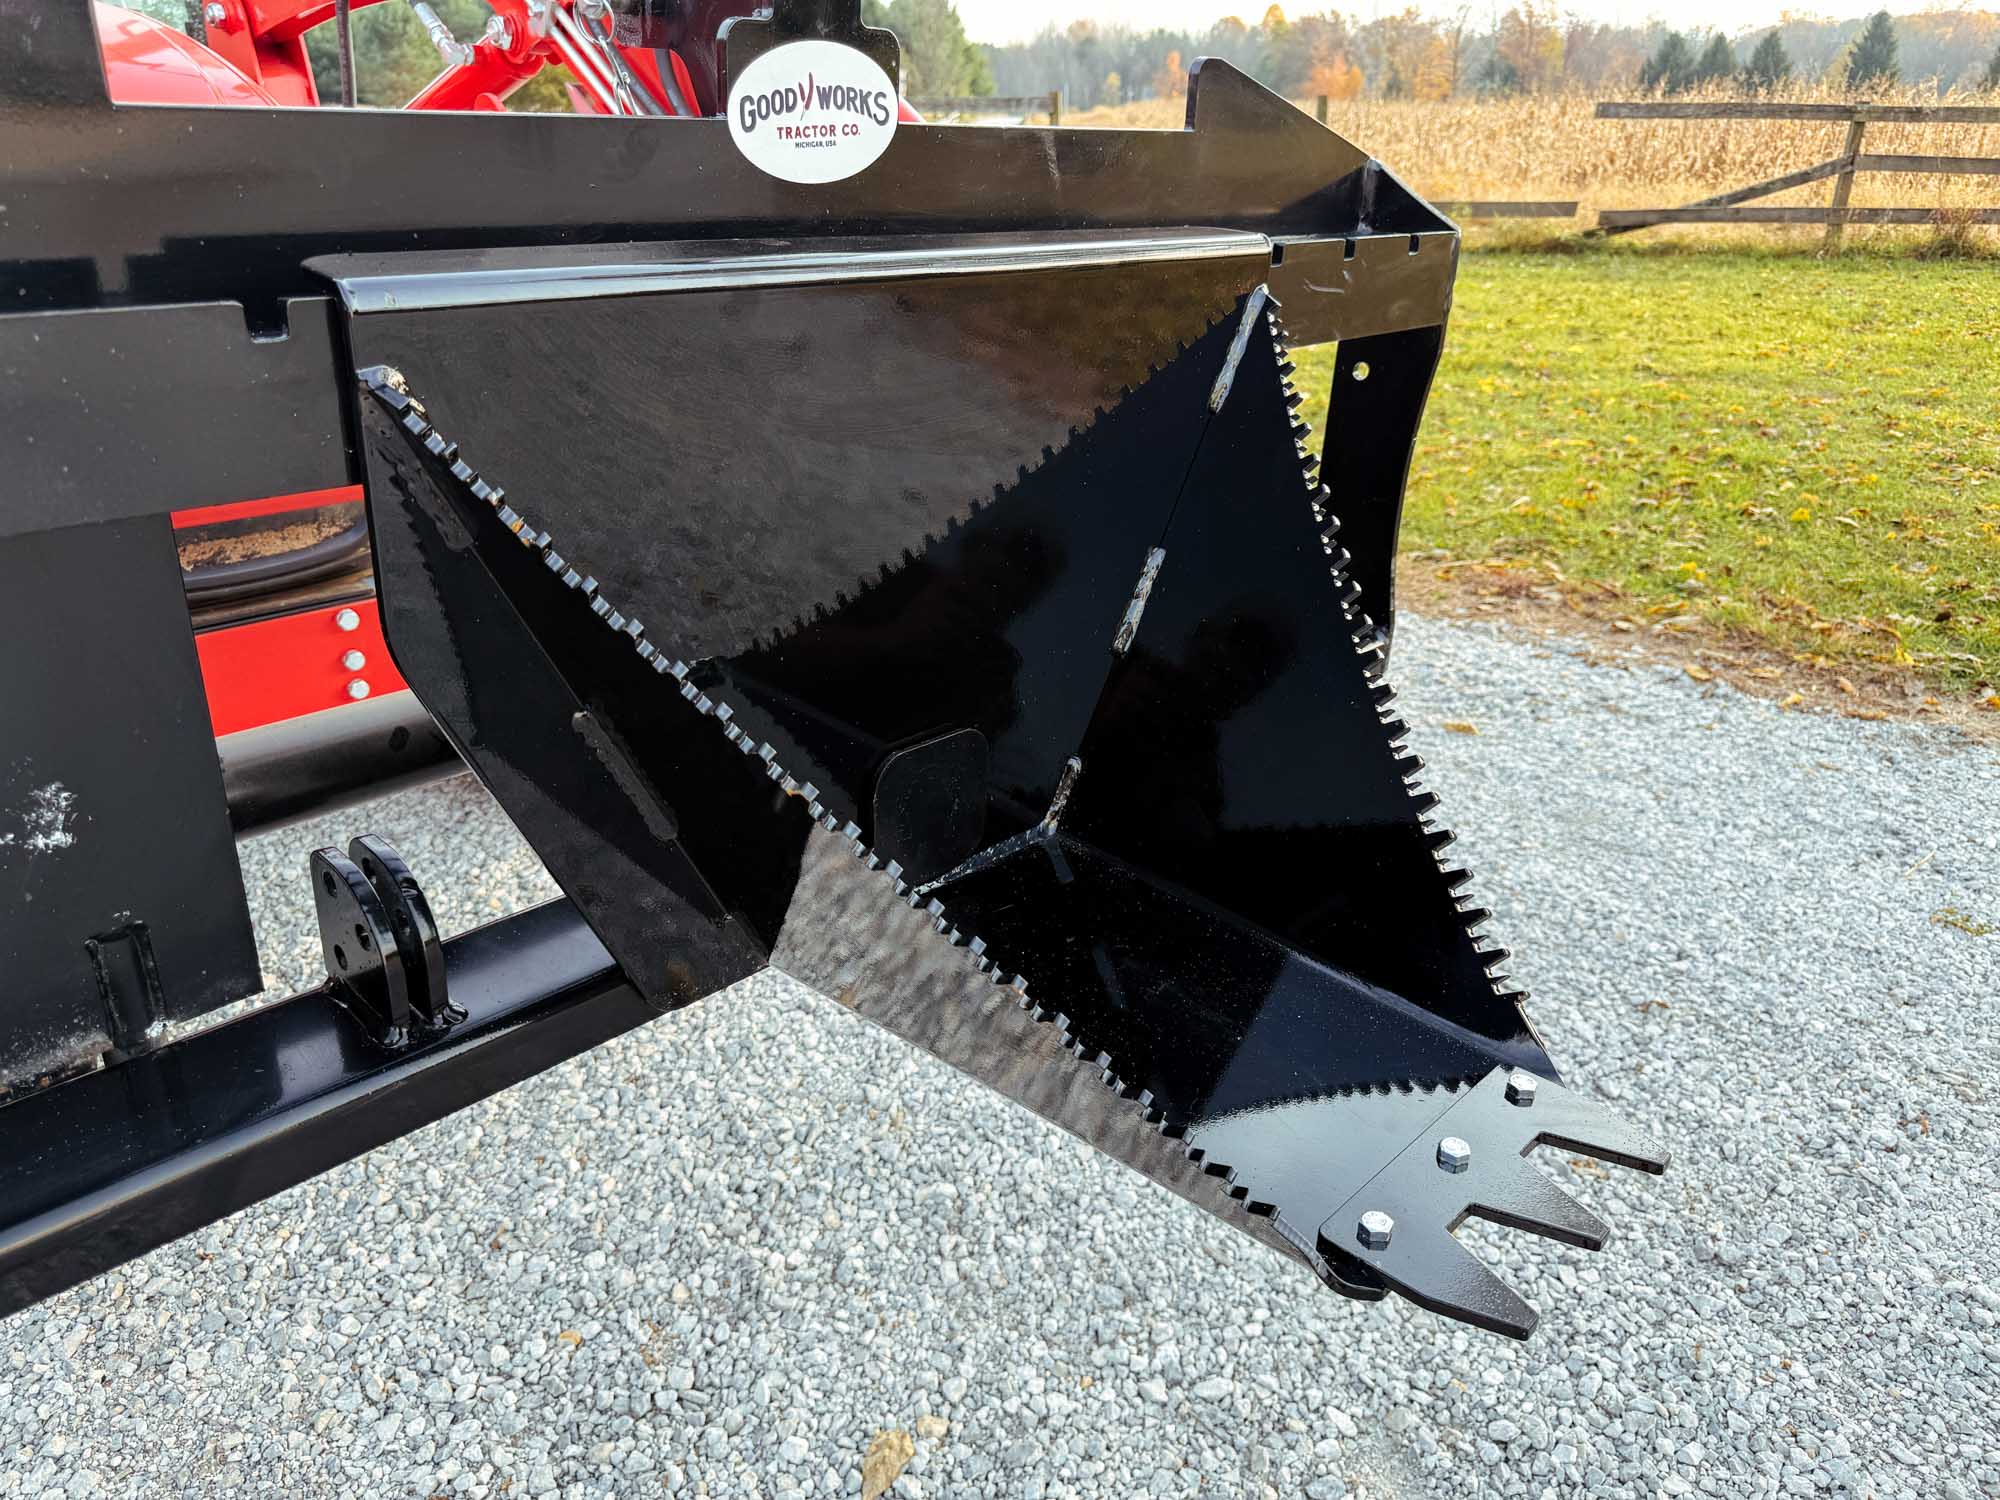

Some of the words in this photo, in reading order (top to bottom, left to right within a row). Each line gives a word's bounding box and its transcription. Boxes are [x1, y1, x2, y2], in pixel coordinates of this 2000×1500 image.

[739, 87, 798, 133] GOOD
[815, 85, 890, 126] WORKS
[776, 124, 837, 140] TRACTOR
[841, 123, 861, 136] CO.
[795, 141, 825, 149] MICHIGAN,
